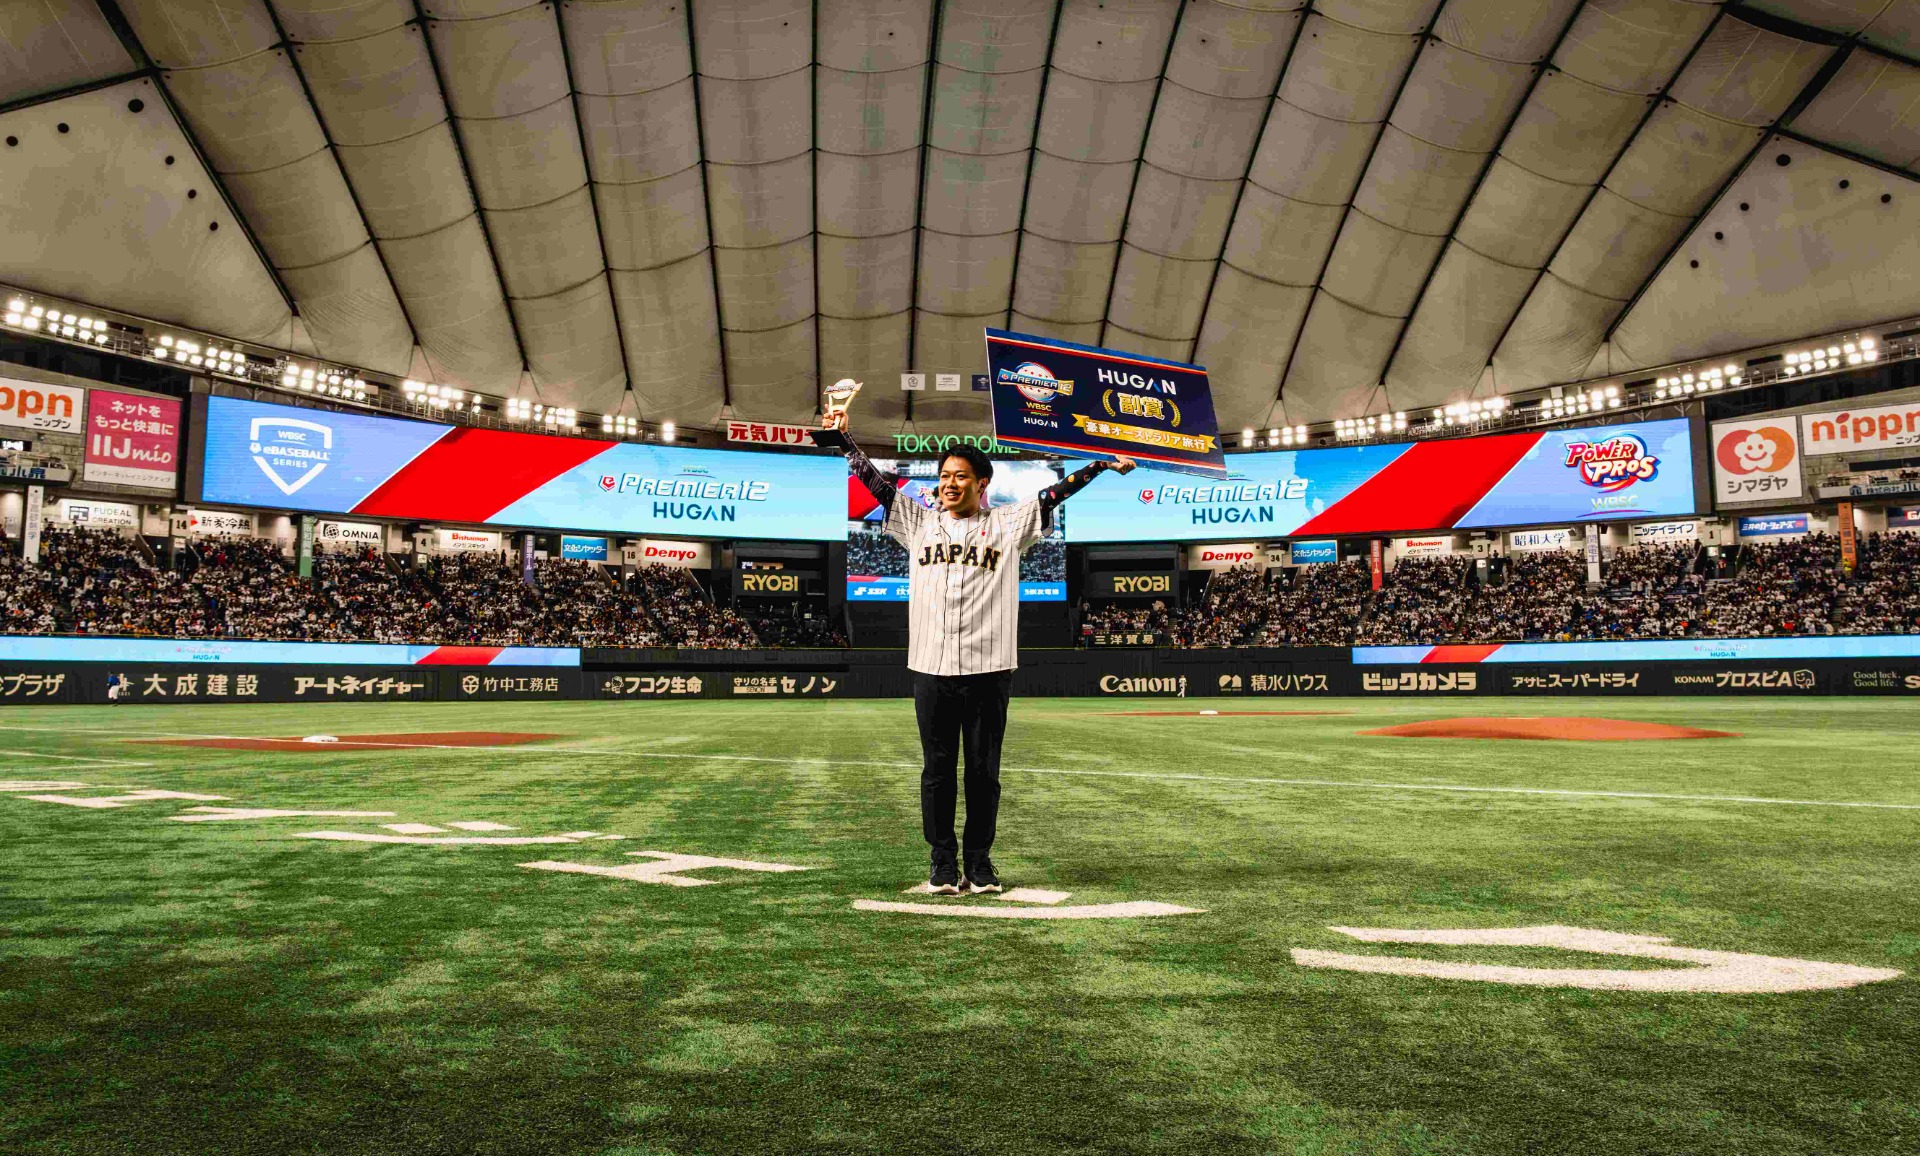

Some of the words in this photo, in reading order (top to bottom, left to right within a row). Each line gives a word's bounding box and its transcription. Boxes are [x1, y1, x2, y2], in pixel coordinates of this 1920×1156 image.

[1060, 382, 1072, 392] 12
[1098, 368, 1176, 395] HUGAN
[111, 400, 161, 418] ネットを
[1026, 401, 1052, 411] WBSC
[1117, 392, 1165, 420] 副賞
[33, 417, 71, 429] ニップン
[95, 415, 174, 435] もっと快適に
[1023, 416, 1058, 428] HUGAN
[278, 430, 306, 440] WBSC
[1086, 420, 1205, 450] 豪華オーストラリア旅行
[893, 434, 960, 453] TOKYO
[272, 458, 308, 468] SERIES
[1728, 475, 1788, 494] シマダヤ
[653, 501, 735, 521] HUGAN
[1192, 506, 1273, 524] HUGAN
[92, 517, 131, 525] CREATION
[176, 520, 187, 529] 14
[201, 516, 250, 530] 新菱冷熱
[342, 529, 379, 540] OMNIA
[1634, 524, 1694, 536] ニッテイライフ
[1514, 532, 1565, 546] 昭和大学
[627, 551, 636, 559] 16
[645, 546, 697, 561] Denyo
[918, 543, 1002, 572] JAPAN
[1201, 550, 1254, 563] Denyo
[1270, 554, 1280, 562] 34
[742, 574, 799, 592] RYOBI
[1113, 575, 1170, 593] RYOBI
[1095, 634, 1154, 645] 三洋貿易
[734, 677, 777, 686] 守りの名手
[1251, 674, 1329, 691] 積水ハウス
[1363, 672, 1476, 691] ビックカメラ
[1512, 673, 1640, 688] アサヒスーパードライ
[1674, 675, 1714, 684] KONAMI
[1716, 671, 1793, 688] プロスピA
[1853, 671, 1877, 679] Good
[1879, 671, 1901, 679] luck.
[143, 673, 259, 696] 大成建設
[294, 675, 424, 695] アートネイチャー
[483, 677, 558, 692] 竹中工務店
[625, 676, 703, 694] フコク生命
[780, 676, 837, 693] セノン
[1100, 674, 1176, 692] Canon
[1854, 679, 1878, 687] Good
[1880, 679, 1898, 687] life.
